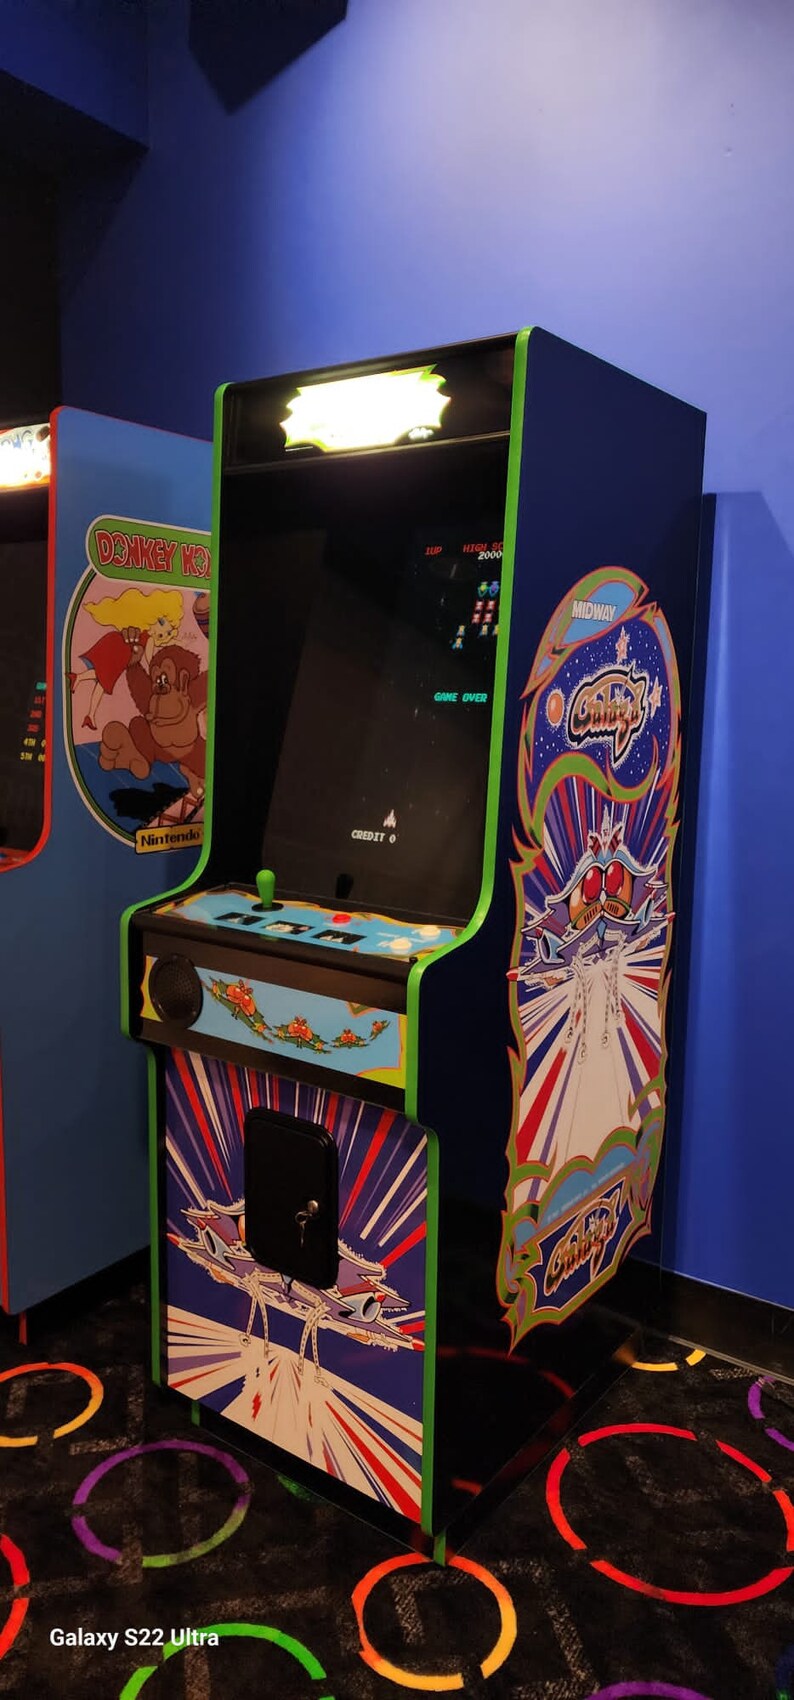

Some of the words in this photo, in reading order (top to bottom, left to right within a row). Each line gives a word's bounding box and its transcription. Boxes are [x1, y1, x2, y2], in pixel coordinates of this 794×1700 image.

[95, 530, 177, 572] DONKEY
[425, 546, 443, 556] 1UP
[463, 543, 488, 553] HIGH
[477, 550, 502, 560] 2000
[571, 600, 616, 622] MIDWAY
[434, 692, 458, 702] GAME
[462, 693, 488, 703] OVER
[141, 829, 200, 847] Nintendo
[351, 829, 385, 842] CREDIT
[388, 834, 396, 844] 0
